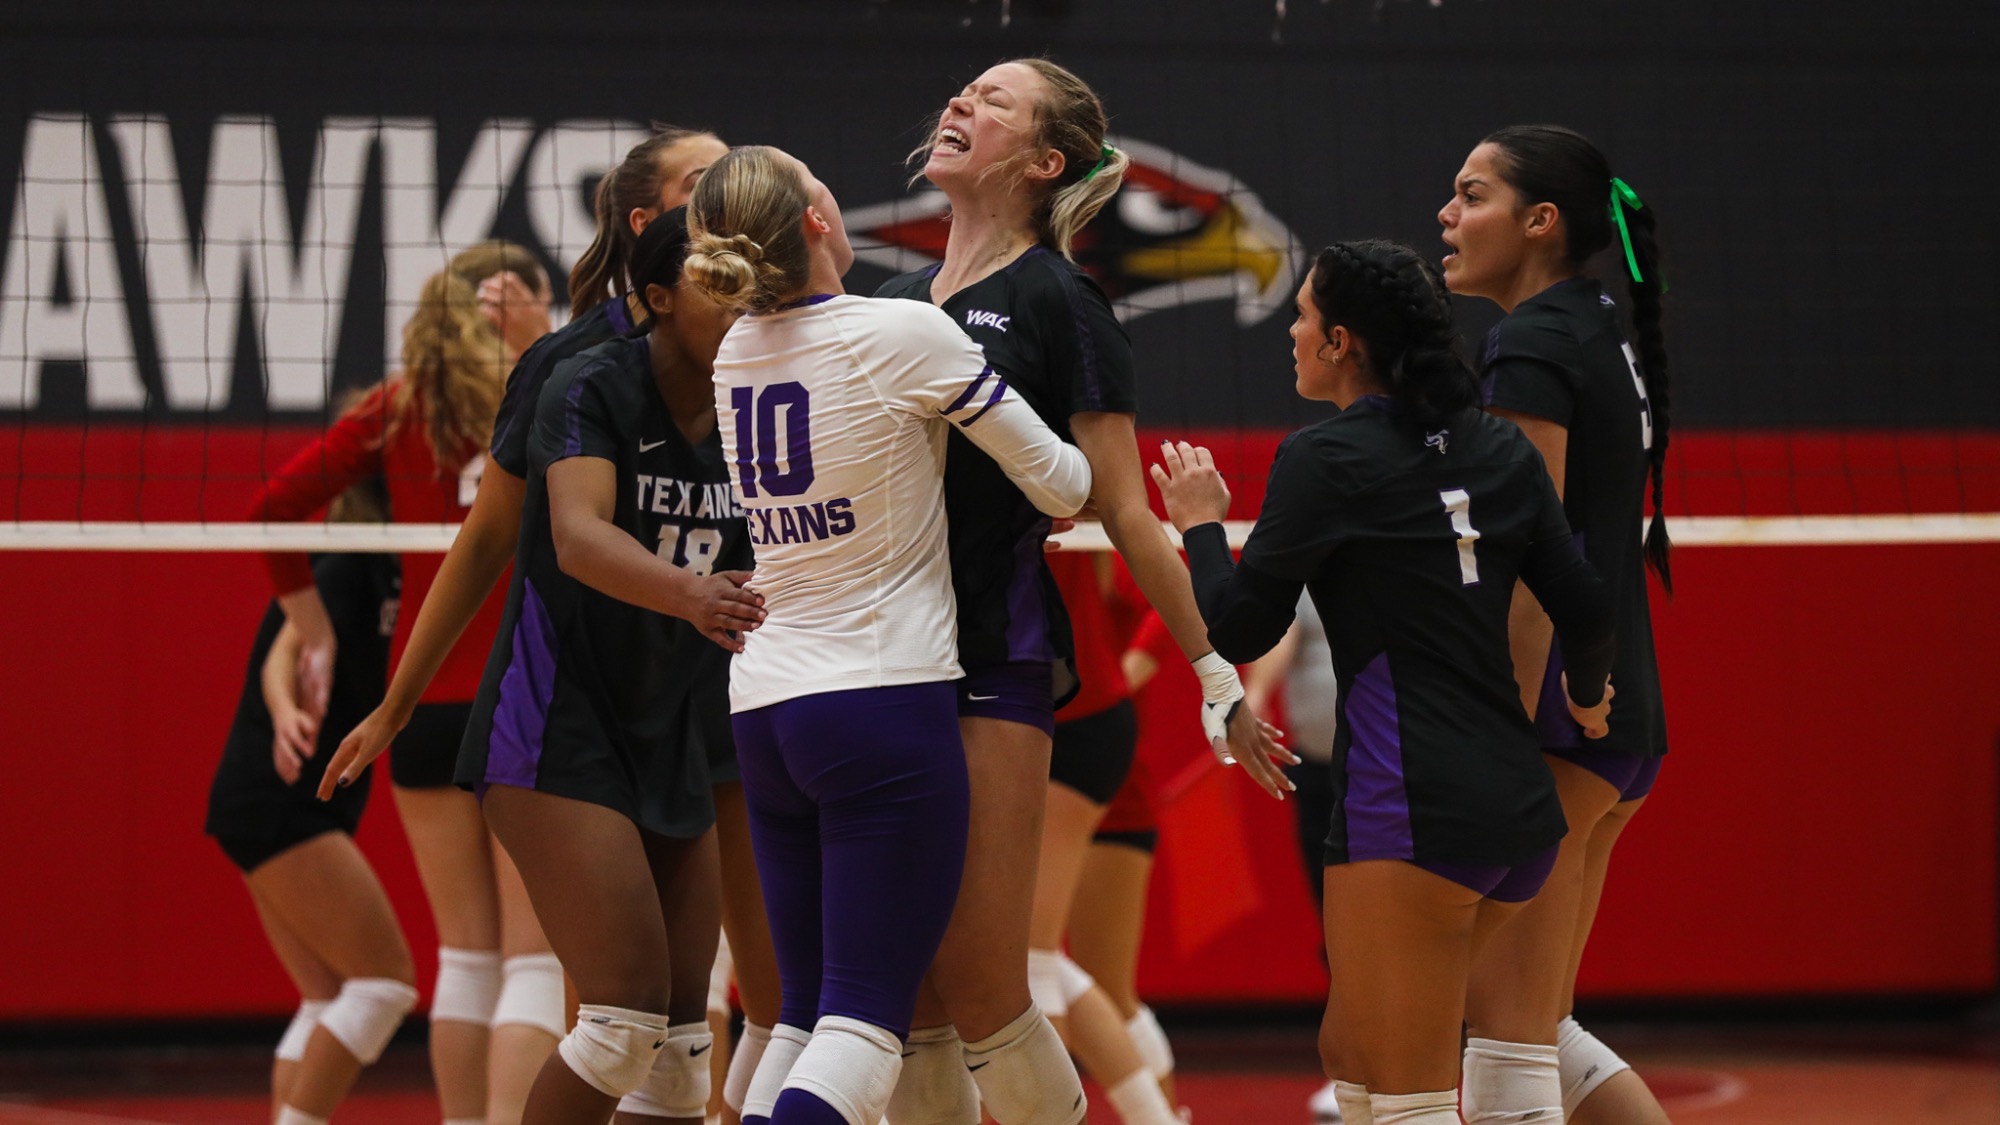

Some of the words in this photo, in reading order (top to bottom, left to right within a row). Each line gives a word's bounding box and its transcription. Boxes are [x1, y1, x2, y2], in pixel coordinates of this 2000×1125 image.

[966, 309, 1011, 332] WAC
[731, 381, 815, 498] 10
[656, 524, 722, 577] 18
[1439, 487, 1479, 585] 1
